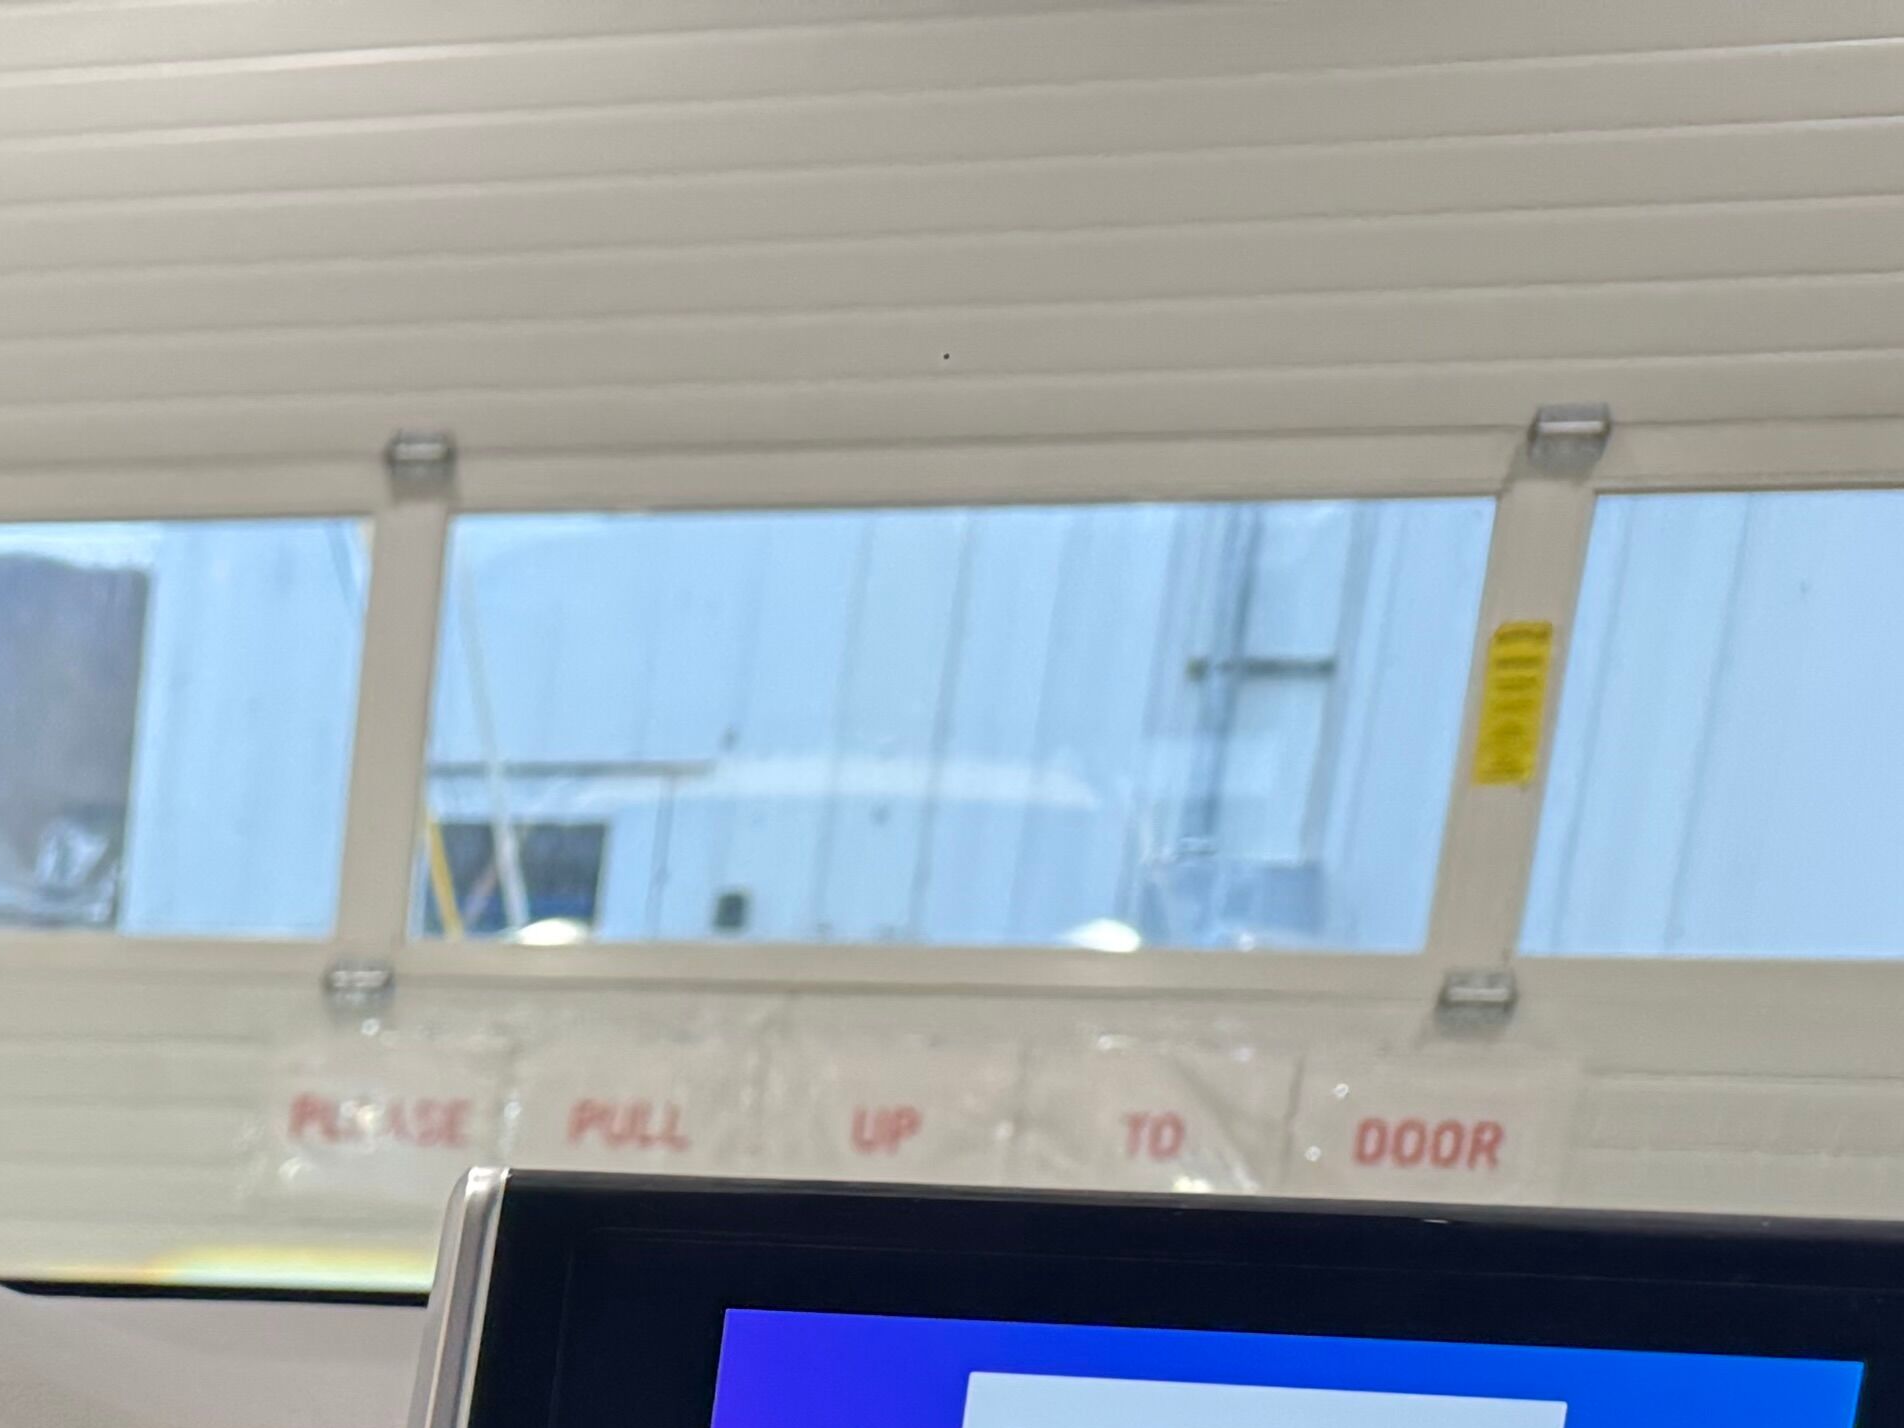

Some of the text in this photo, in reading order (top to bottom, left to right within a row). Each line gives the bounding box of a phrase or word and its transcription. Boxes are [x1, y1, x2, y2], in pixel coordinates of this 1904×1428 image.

[567, 1098, 690, 1151] PULL
[850, 1106, 925, 1154] UP
[1122, 1112, 1187, 1161] TO
[1352, 1118, 1507, 1169] DOOR
